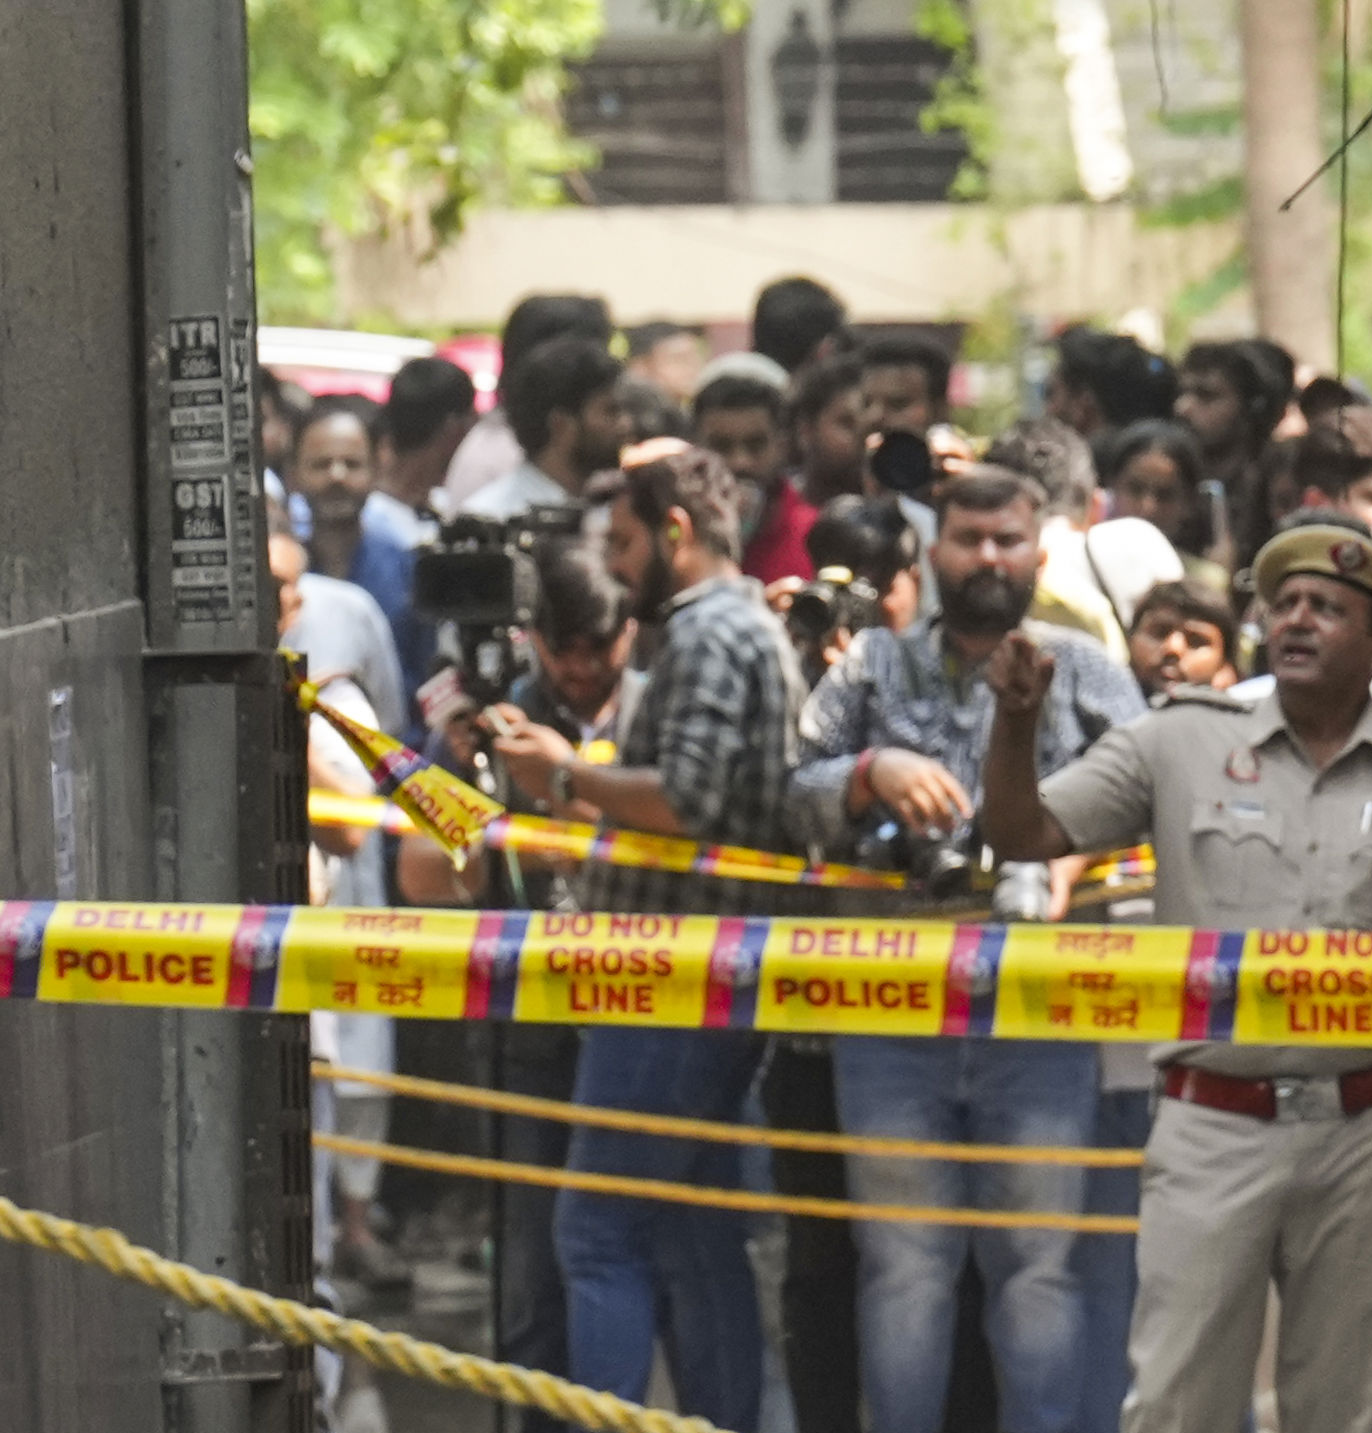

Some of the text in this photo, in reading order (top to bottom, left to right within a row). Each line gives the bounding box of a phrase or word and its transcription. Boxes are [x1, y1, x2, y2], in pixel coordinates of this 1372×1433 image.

[170, 322, 217, 349] ITR
[176, 482, 222, 508] GST
[74, 908, 205, 933] DELHI
[543, 912, 684, 939] DO NOT
[790, 928, 917, 958] DELHI
[1259, 931, 1310, 956] DO
[55, 949, 214, 985] POLICE
[546, 948, 674, 977] CROSS
[568, 982, 655, 1013] LINE
[773, 977, 931, 1010] POLICE
[1288, 1004, 1372, 1033] LINE
